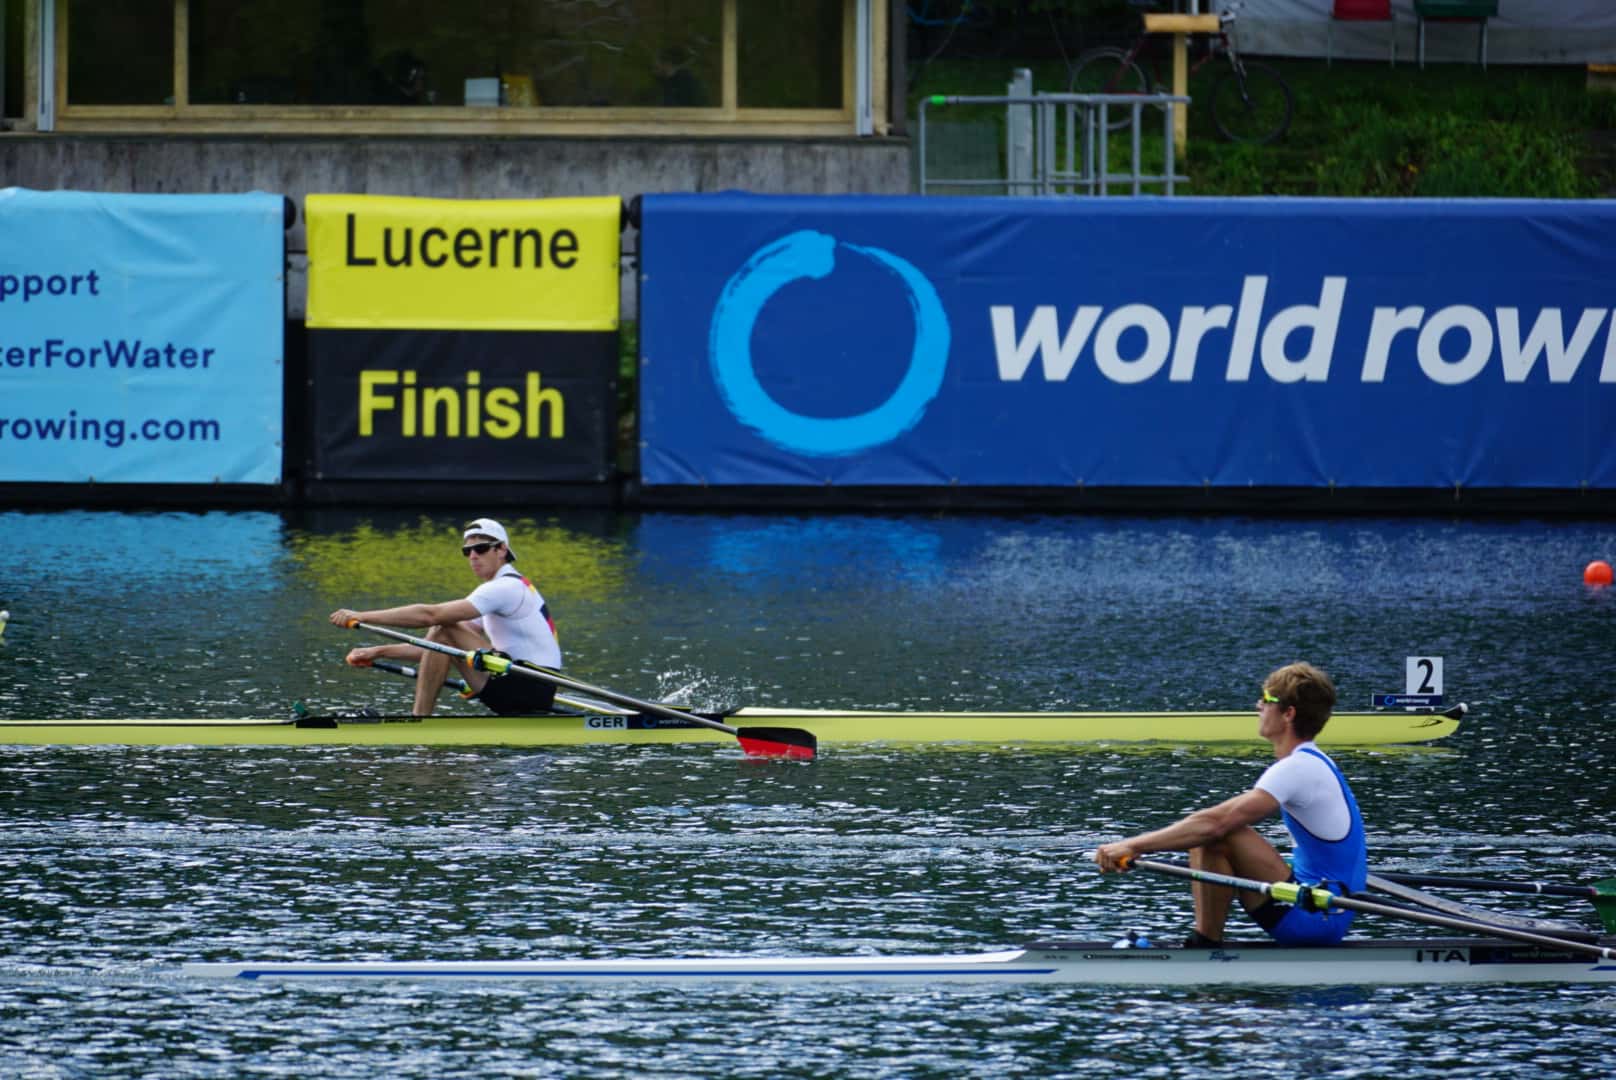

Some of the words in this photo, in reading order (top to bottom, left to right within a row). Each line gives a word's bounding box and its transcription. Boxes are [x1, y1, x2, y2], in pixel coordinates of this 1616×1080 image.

[345, 213, 580, 269] Lucerne
[0, 270, 100, 301] pport
[989, 275, 1348, 384] world
[0, 340, 216, 369] erForWater
[358, 370, 565, 439] Finish
[0, 410, 220, 448] rowing.com
[1416, 658, 1435, 694] 2
[588, 717, 625, 729] GER
[1415, 949, 1468, 963] ITA
